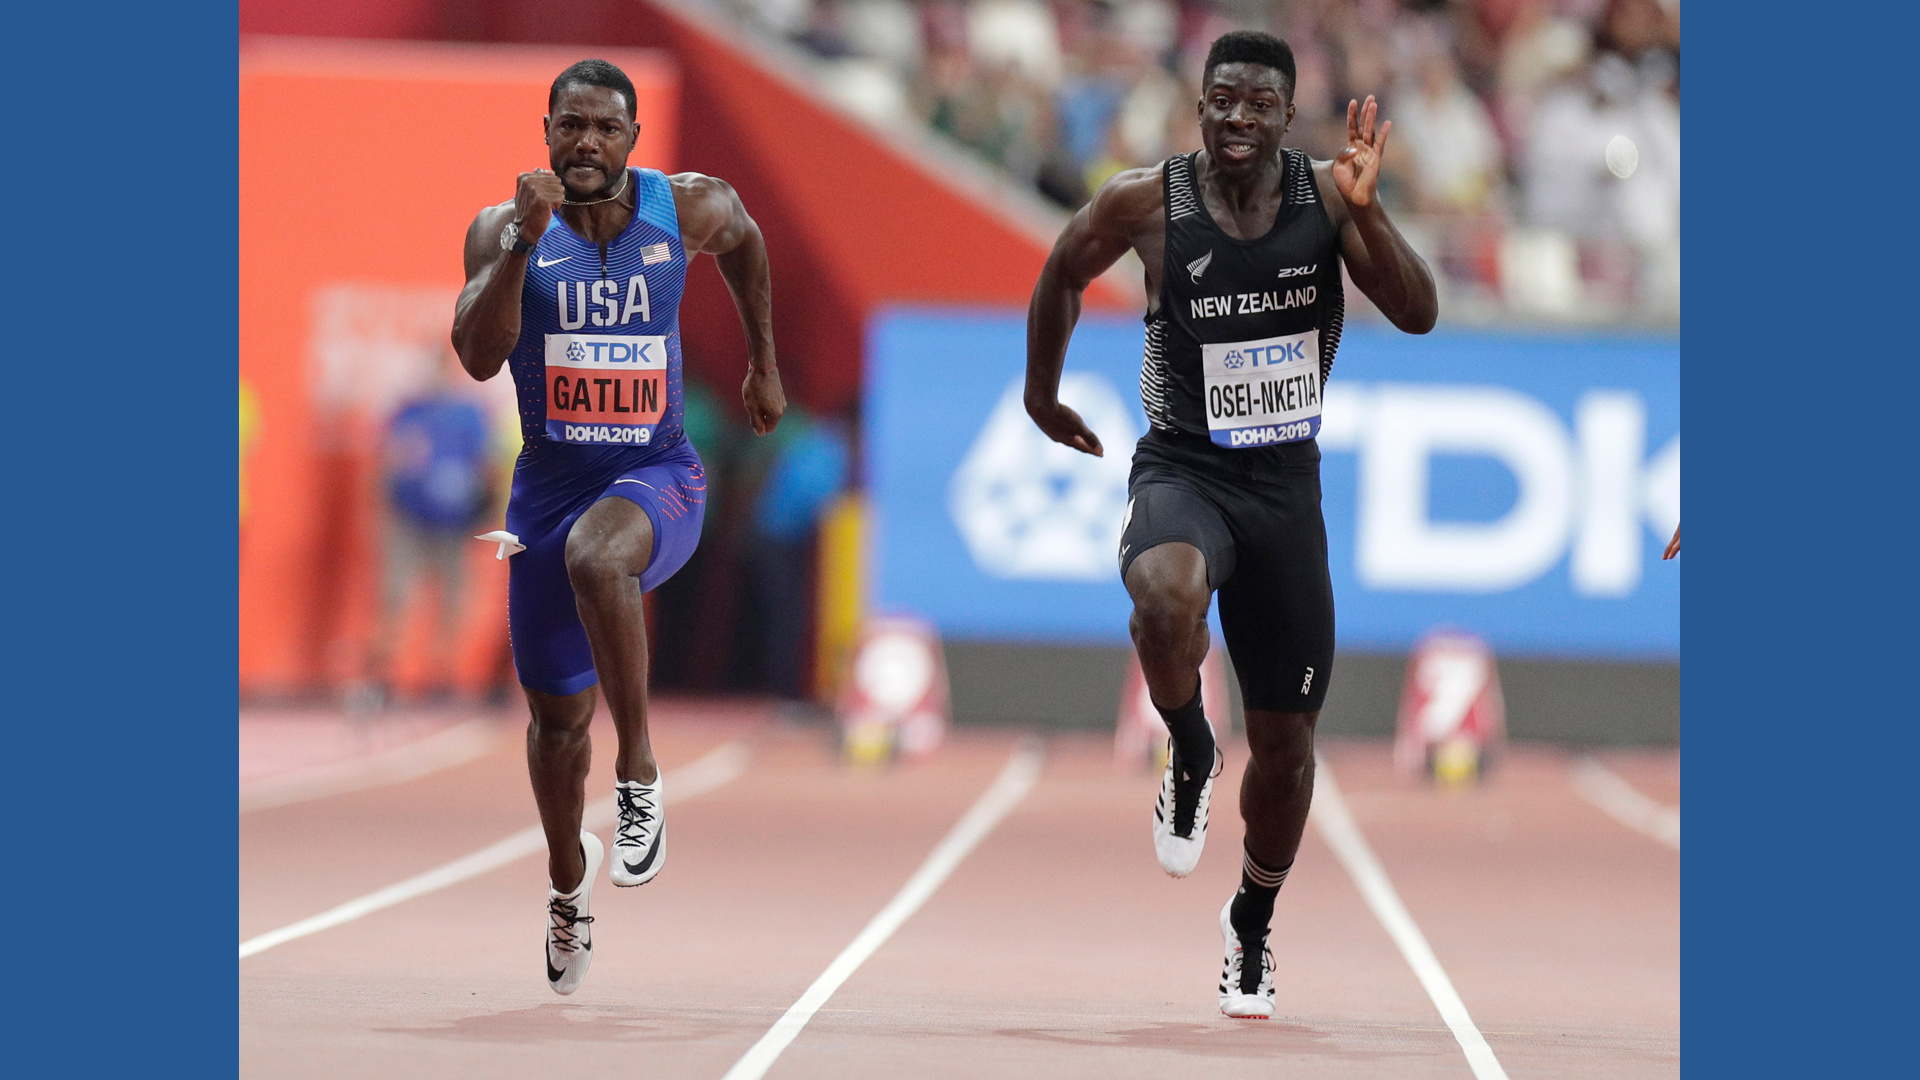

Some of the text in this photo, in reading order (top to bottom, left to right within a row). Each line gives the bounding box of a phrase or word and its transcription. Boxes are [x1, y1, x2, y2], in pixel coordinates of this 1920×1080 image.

[1277, 264, 1318, 279] 2XU
[557, 274, 651, 331] USA
[1190, 285, 1317, 319] NEW ZEALAND
[586, 342, 652, 363] TDK
[1244, 340, 1305, 368] TDK
[553, 375, 658, 413] GATLIN
[1209, 372, 1318, 419] OSEI-NKETIA
[565, 424, 650, 444] DOHA2019
[1230, 420, 1311, 446] DOHA2019
[1322, 382, 1680, 596] DK
[1300, 666, 1314, 695] 2XU
